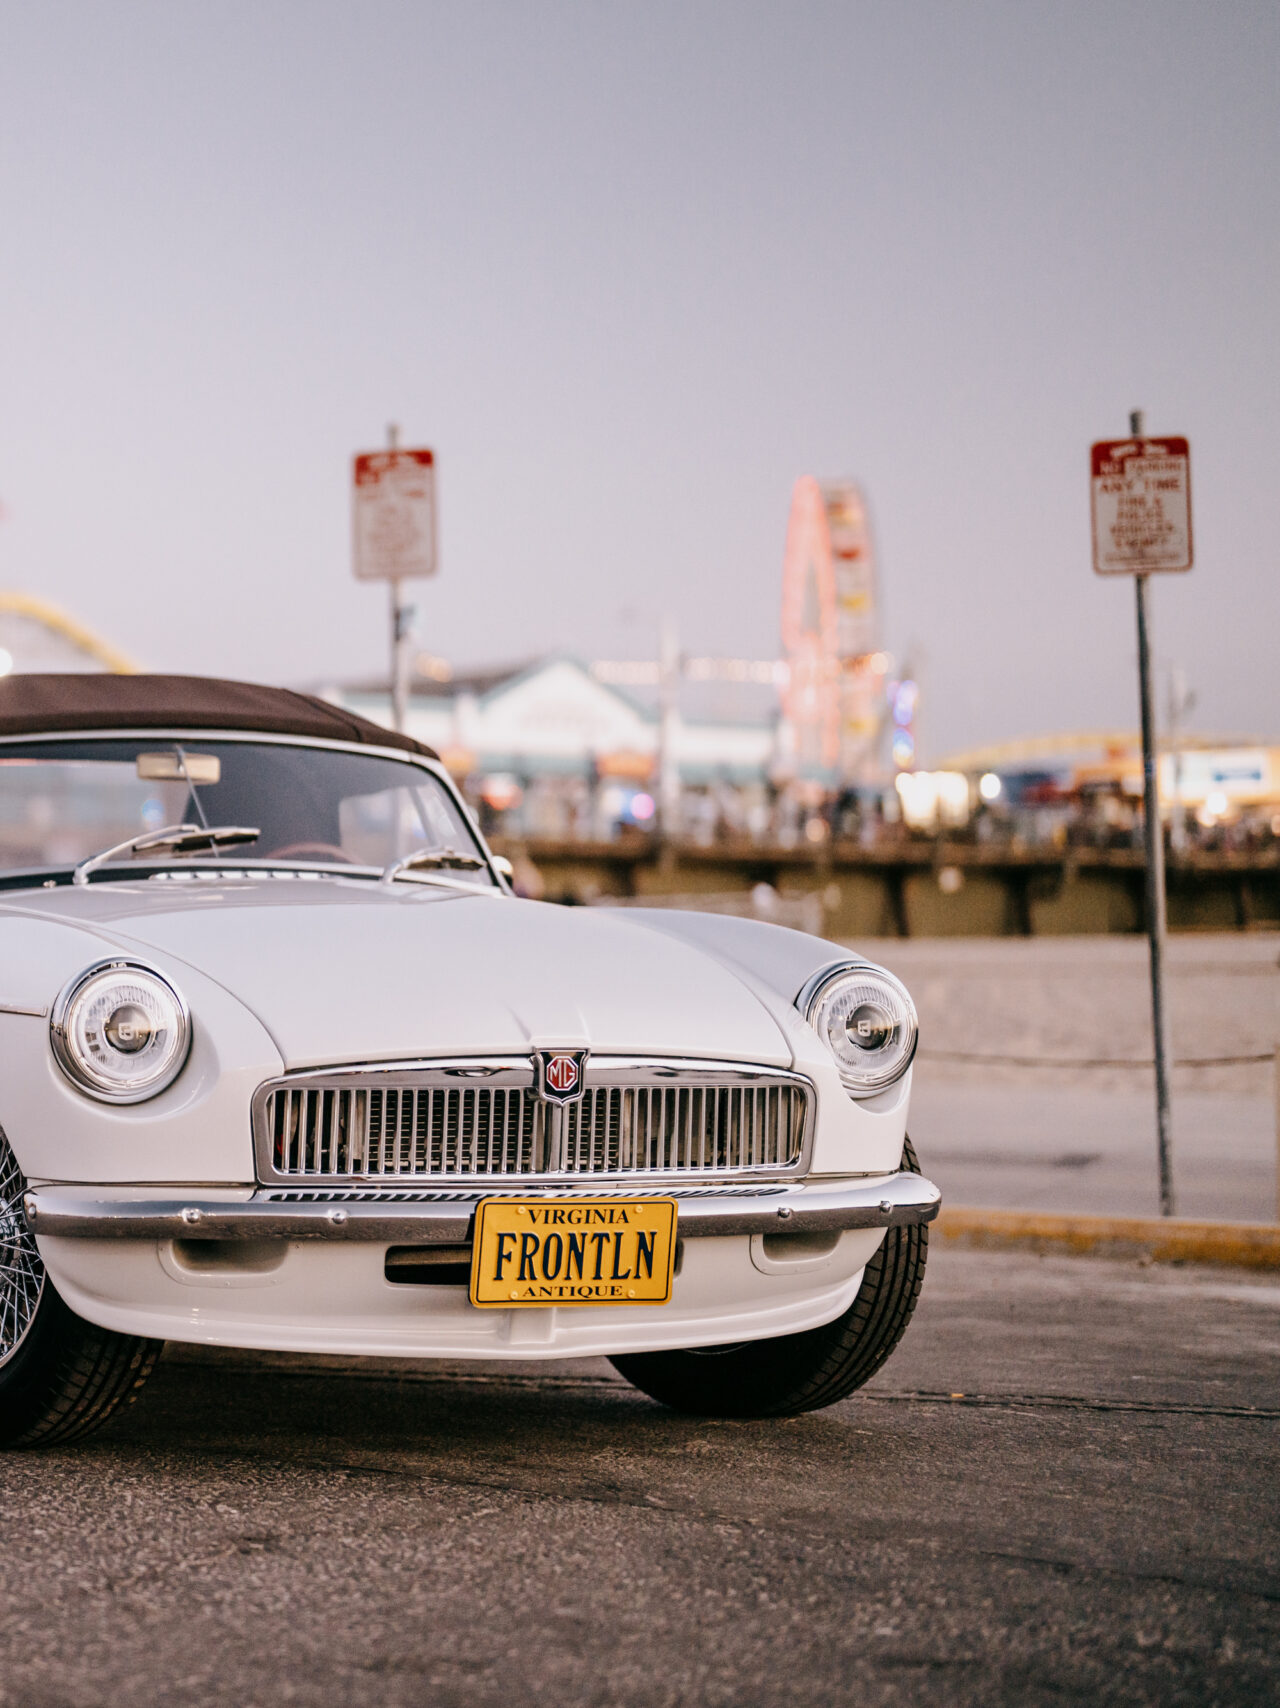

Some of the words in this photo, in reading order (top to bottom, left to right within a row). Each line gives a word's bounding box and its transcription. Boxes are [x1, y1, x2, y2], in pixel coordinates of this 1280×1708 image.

[549, 1059, 576, 1088] MG
[528, 1208, 630, 1225] VIRGINIA
[493, 1231, 658, 1282] FRONTLN
[522, 1285, 624, 1299] ANTIQUE
